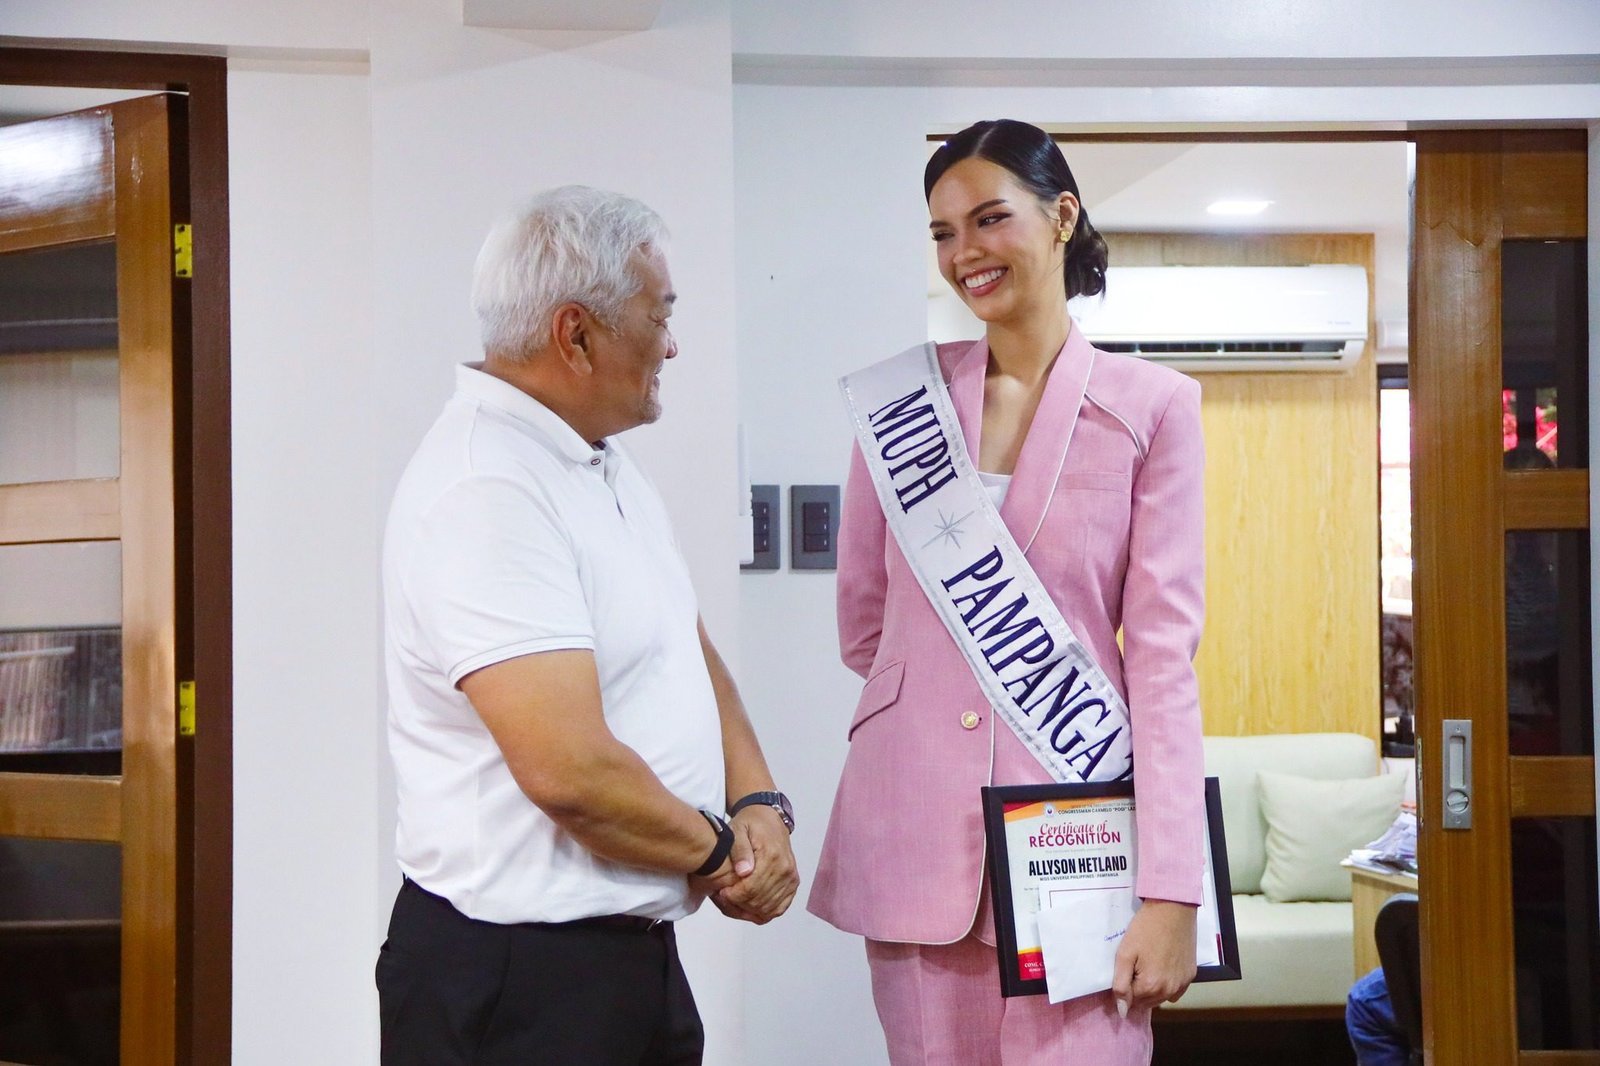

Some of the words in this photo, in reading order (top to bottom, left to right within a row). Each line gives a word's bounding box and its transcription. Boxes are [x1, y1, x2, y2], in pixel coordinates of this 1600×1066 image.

[868, 384, 959, 514] MUPH
[940, 544, 1124, 783] PAMPANGA
[1040, 822, 1095, 837] Certificate
[1097, 820, 1108, 836] of
[1029, 832, 1121, 848] RECOGNITION
[1029, 859, 1076, 877] ALLYSON
[1079, 855, 1127, 873] HETLAND
